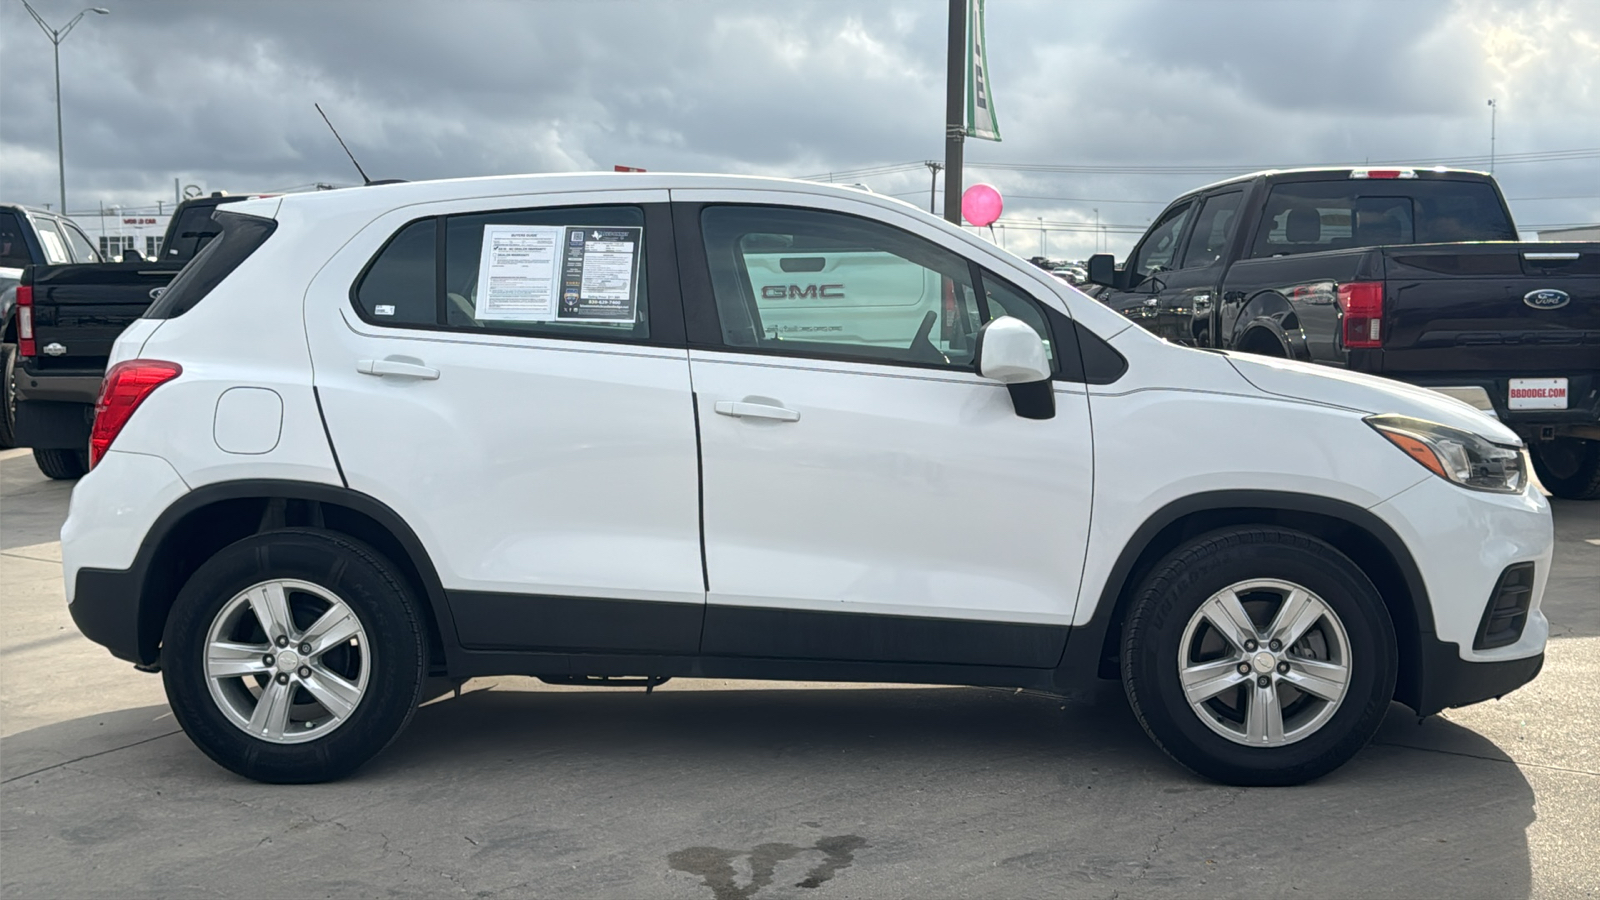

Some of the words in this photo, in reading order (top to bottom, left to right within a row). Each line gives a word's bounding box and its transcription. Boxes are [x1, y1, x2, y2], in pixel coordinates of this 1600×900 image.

[761, 284, 844, 299] GMC
[1535, 293, 1561, 304] Ford
[1510, 388, 1566, 398] BBDODGE.COM
